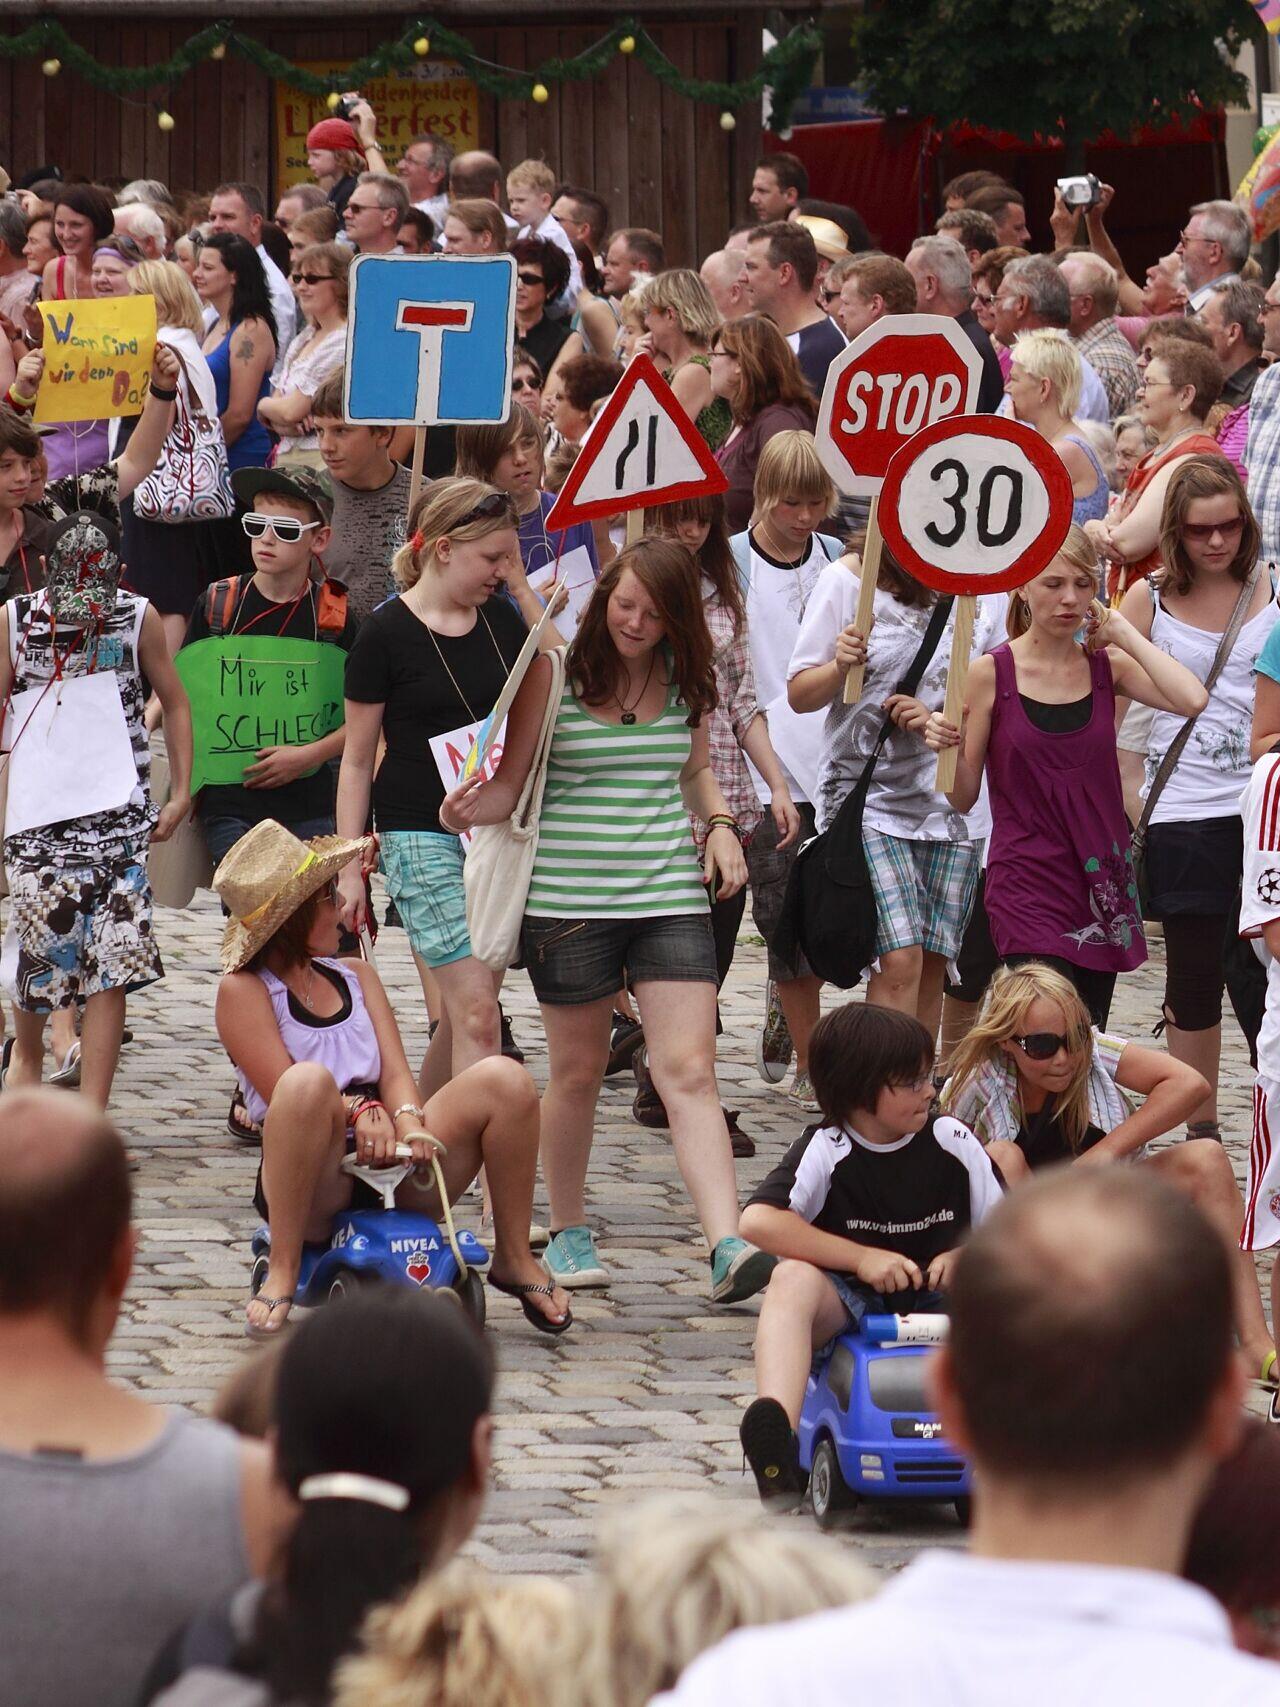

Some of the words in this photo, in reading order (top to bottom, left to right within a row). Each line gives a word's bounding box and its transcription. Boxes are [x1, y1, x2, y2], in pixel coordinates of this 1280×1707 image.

[47, 312, 99, 349] Wann
[79, 355, 114, 384] denn
[840, 370, 962, 436] STOP
[924, 458, 1023, 547] 30
[220, 653, 266, 696] Mir
[286, 669, 310, 696] ist
[391, 1237, 439, 1253] NIVEA
[914, 1423, 942, 1432] MAN
